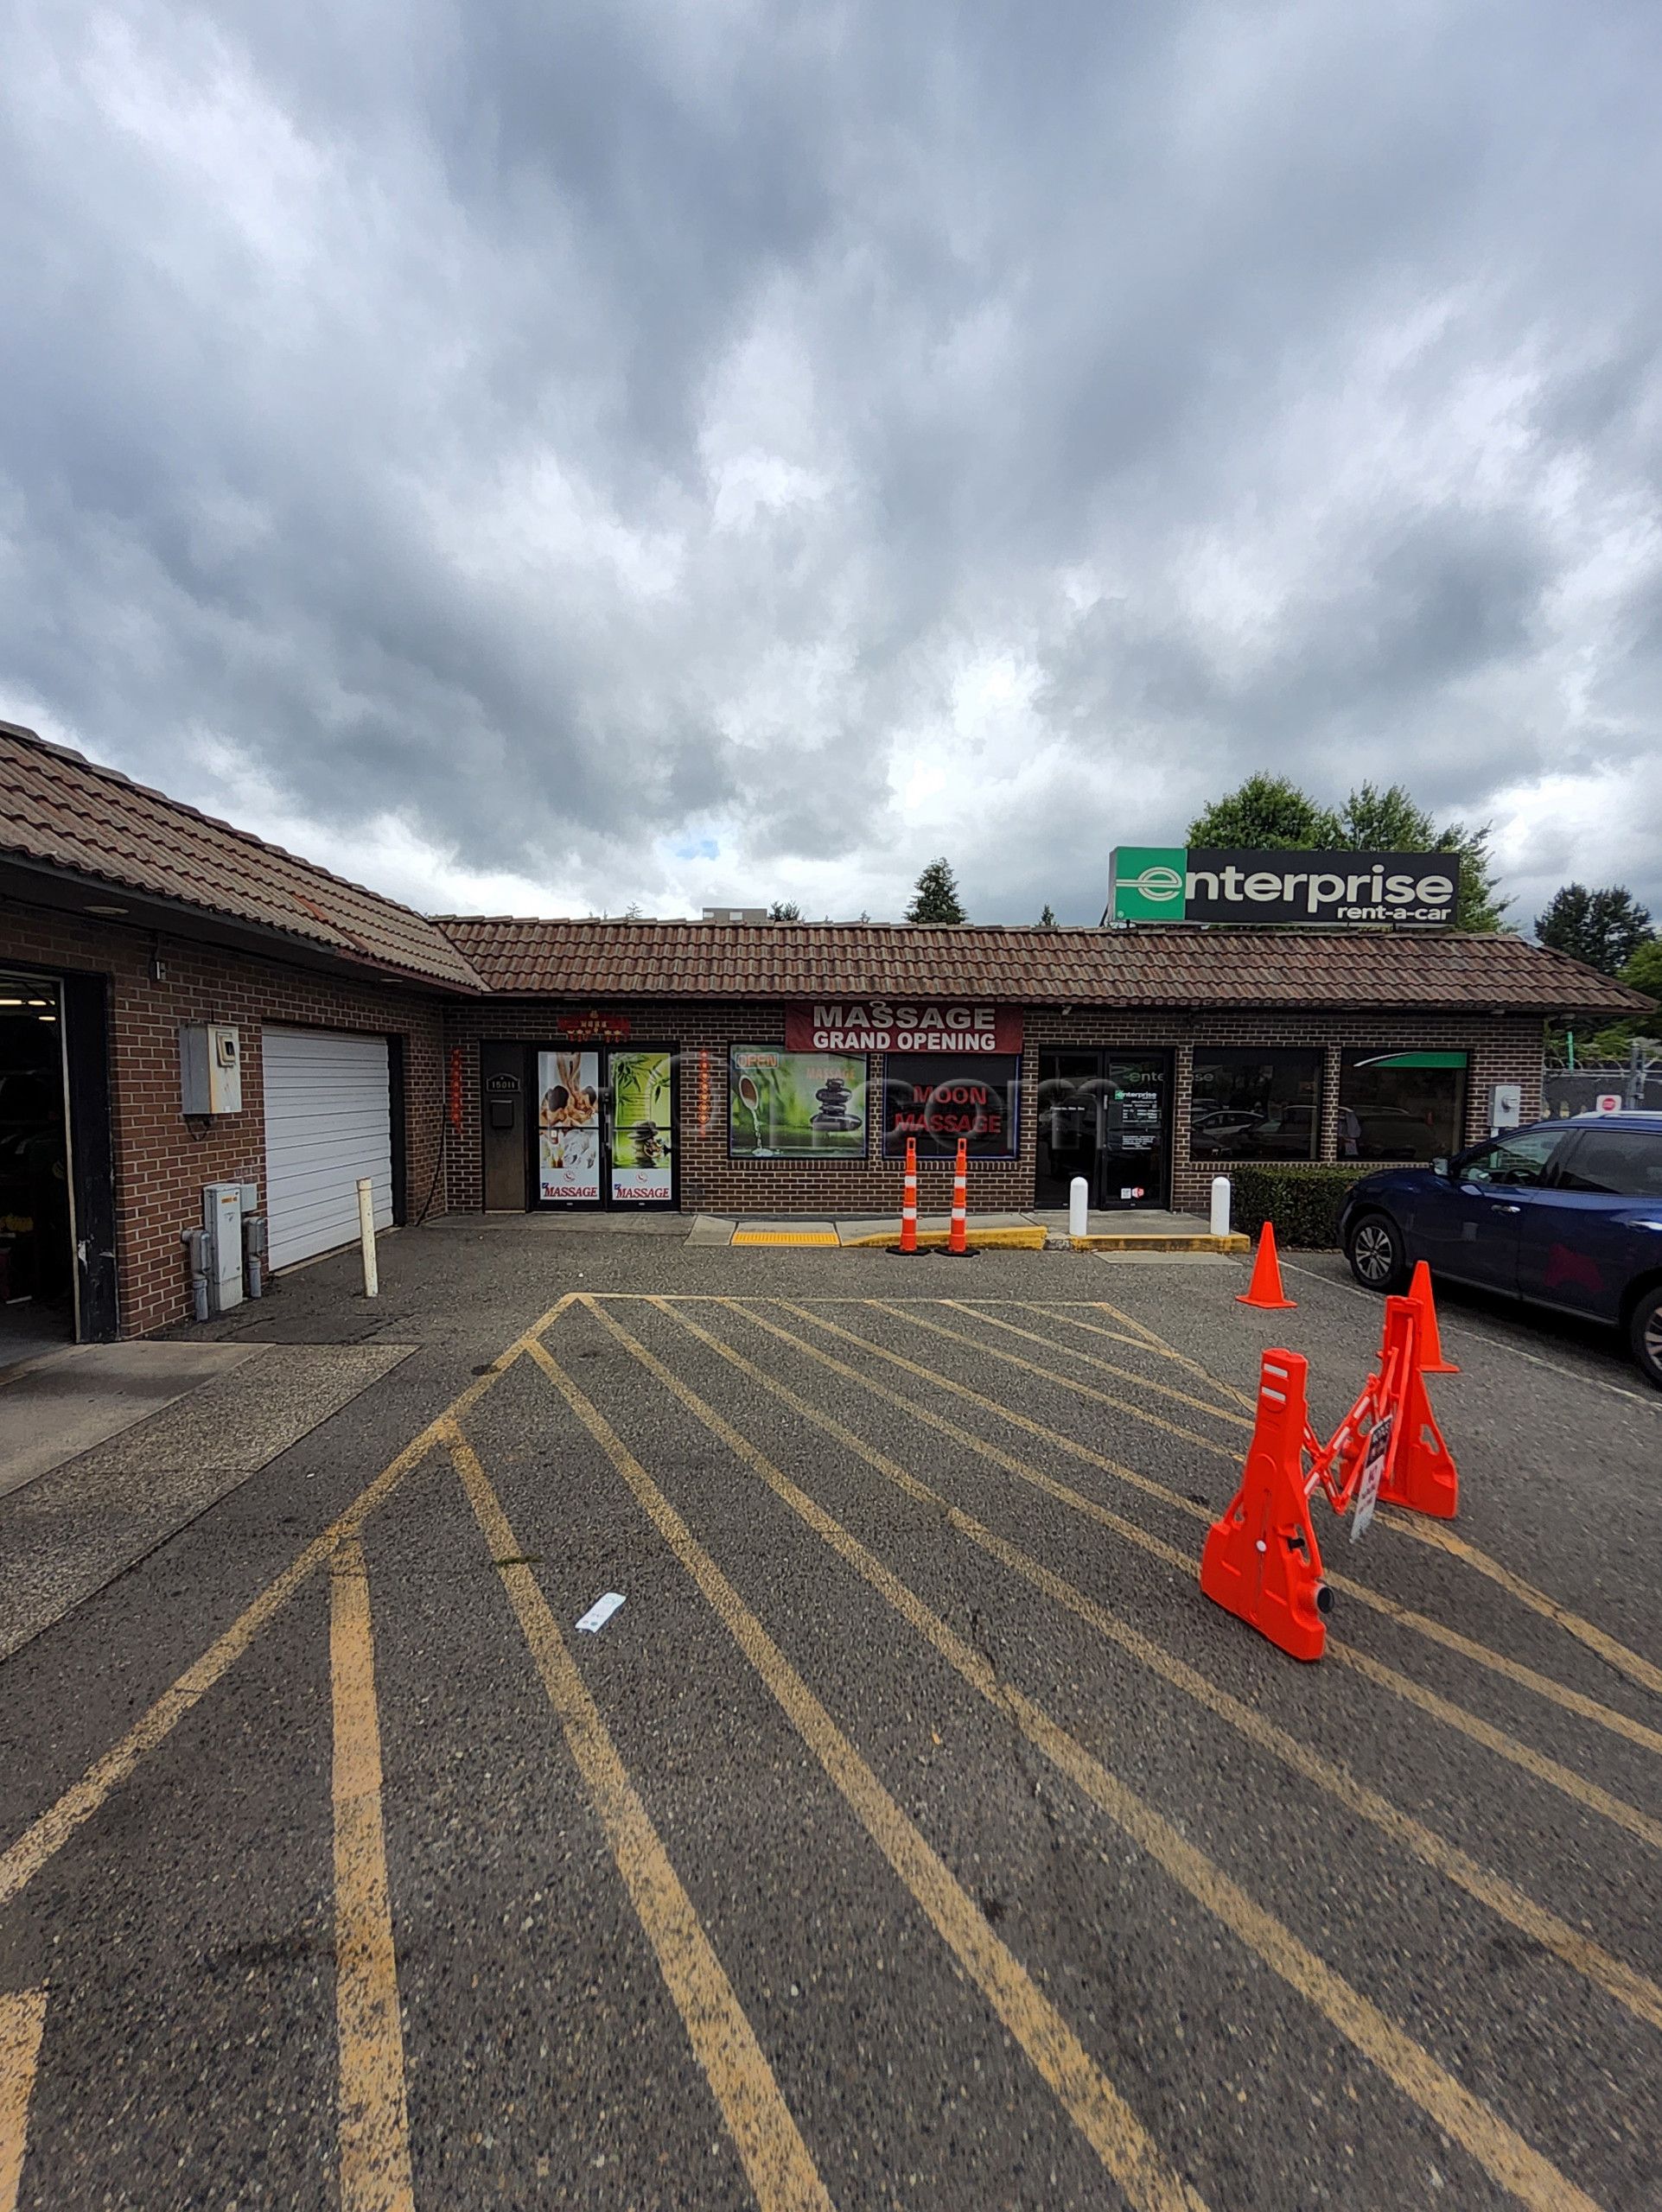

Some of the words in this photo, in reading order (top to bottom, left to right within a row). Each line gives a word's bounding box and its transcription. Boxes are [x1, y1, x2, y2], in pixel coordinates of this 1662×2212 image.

[1117, 864, 1454, 913] enterprise
[1337, 905, 1452, 921] rent-a-car
[813, 1005, 997, 1031] MASSAGE
[812, 1032, 891, 1051] GRAND
[897, 1032, 997, 1052] OPENING
[737, 1054, 778, 1068] OPEN
[806, 1067, 856, 1080] MASSAGE
[913, 1086, 987, 1105] MOON
[895, 1112, 1002, 1135] MASSAGE
[543, 1186, 598, 1198] MASSAGE
[615, 1187, 670, 1198] MASSAGE
